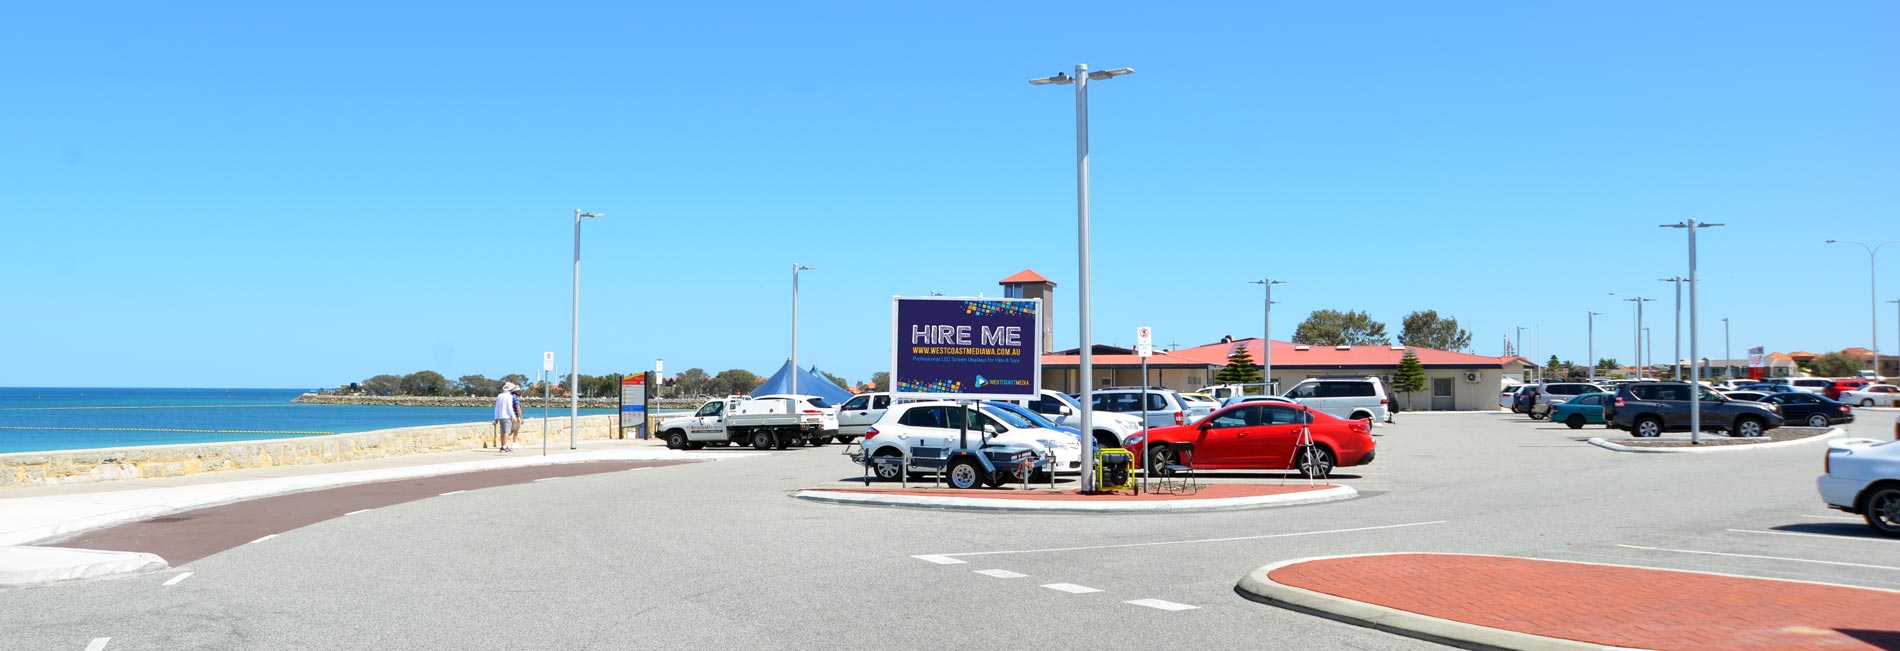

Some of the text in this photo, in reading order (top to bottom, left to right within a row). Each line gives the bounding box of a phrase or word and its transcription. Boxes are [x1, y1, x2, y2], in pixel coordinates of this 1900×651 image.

[912, 324, 1021, 346] HIRE ME
[912, 346, 1021, 355] WWW.WESTCOASTMEDIAWA.COM.AU
